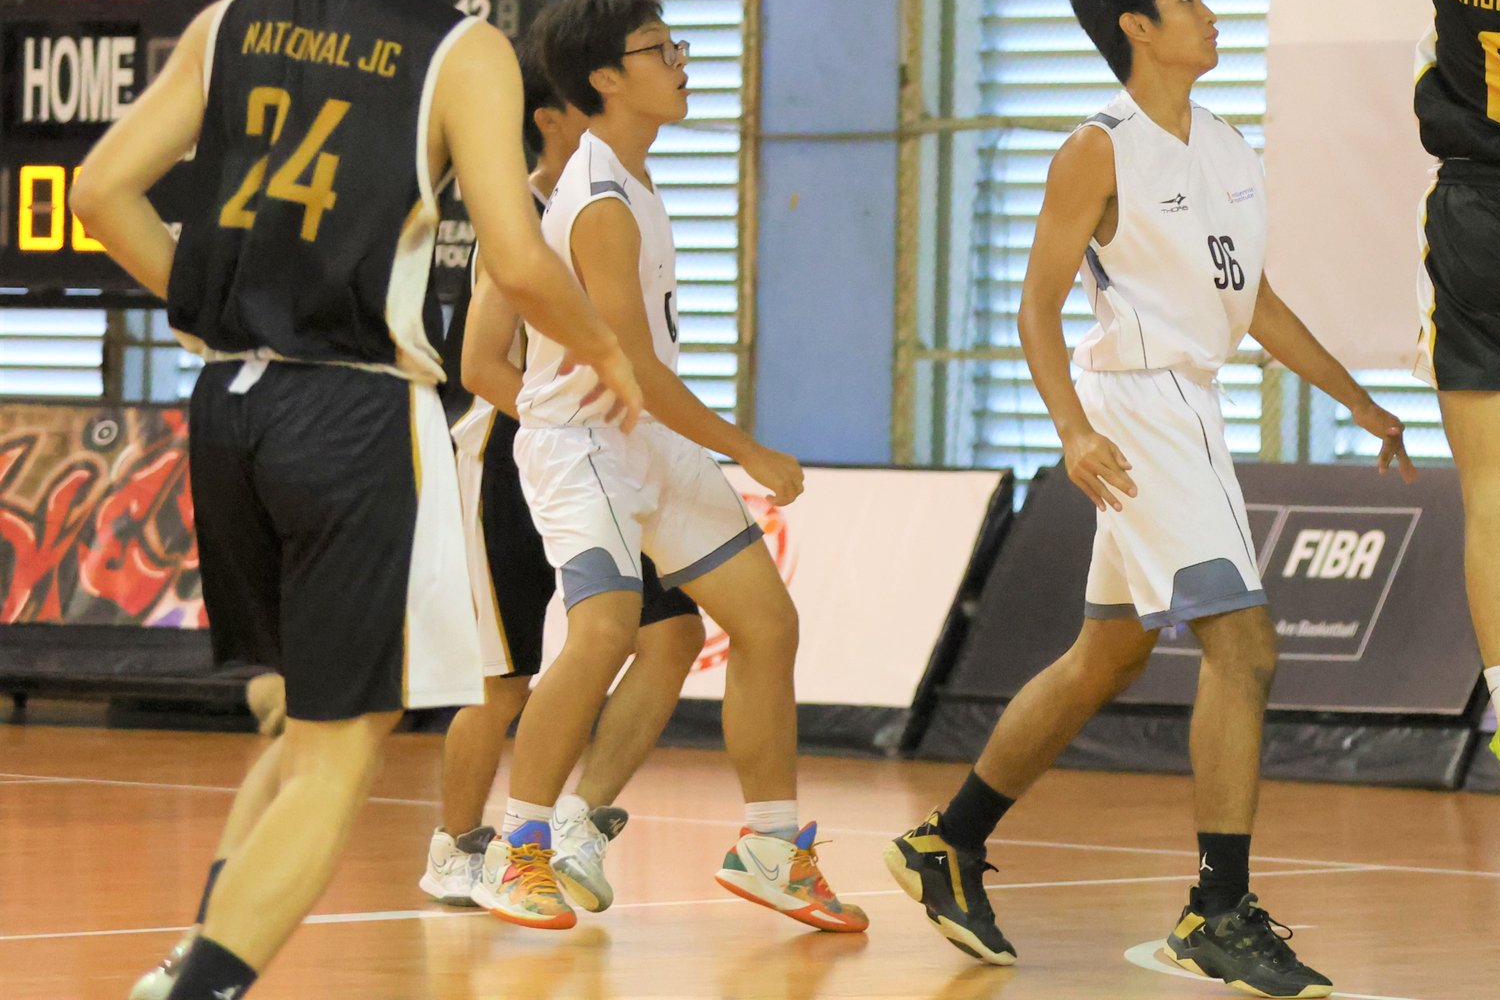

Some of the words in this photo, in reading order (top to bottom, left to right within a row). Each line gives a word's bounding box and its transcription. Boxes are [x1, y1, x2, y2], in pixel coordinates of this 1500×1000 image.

[241, 21, 351, 68] NATONAL
[358, 38, 402, 79] JC
[22, 36, 136, 123] HOME
[218, 86, 352, 243] 24
[1207, 235, 1245, 291] 96
[1282, 529, 1386, 579] FIBA
